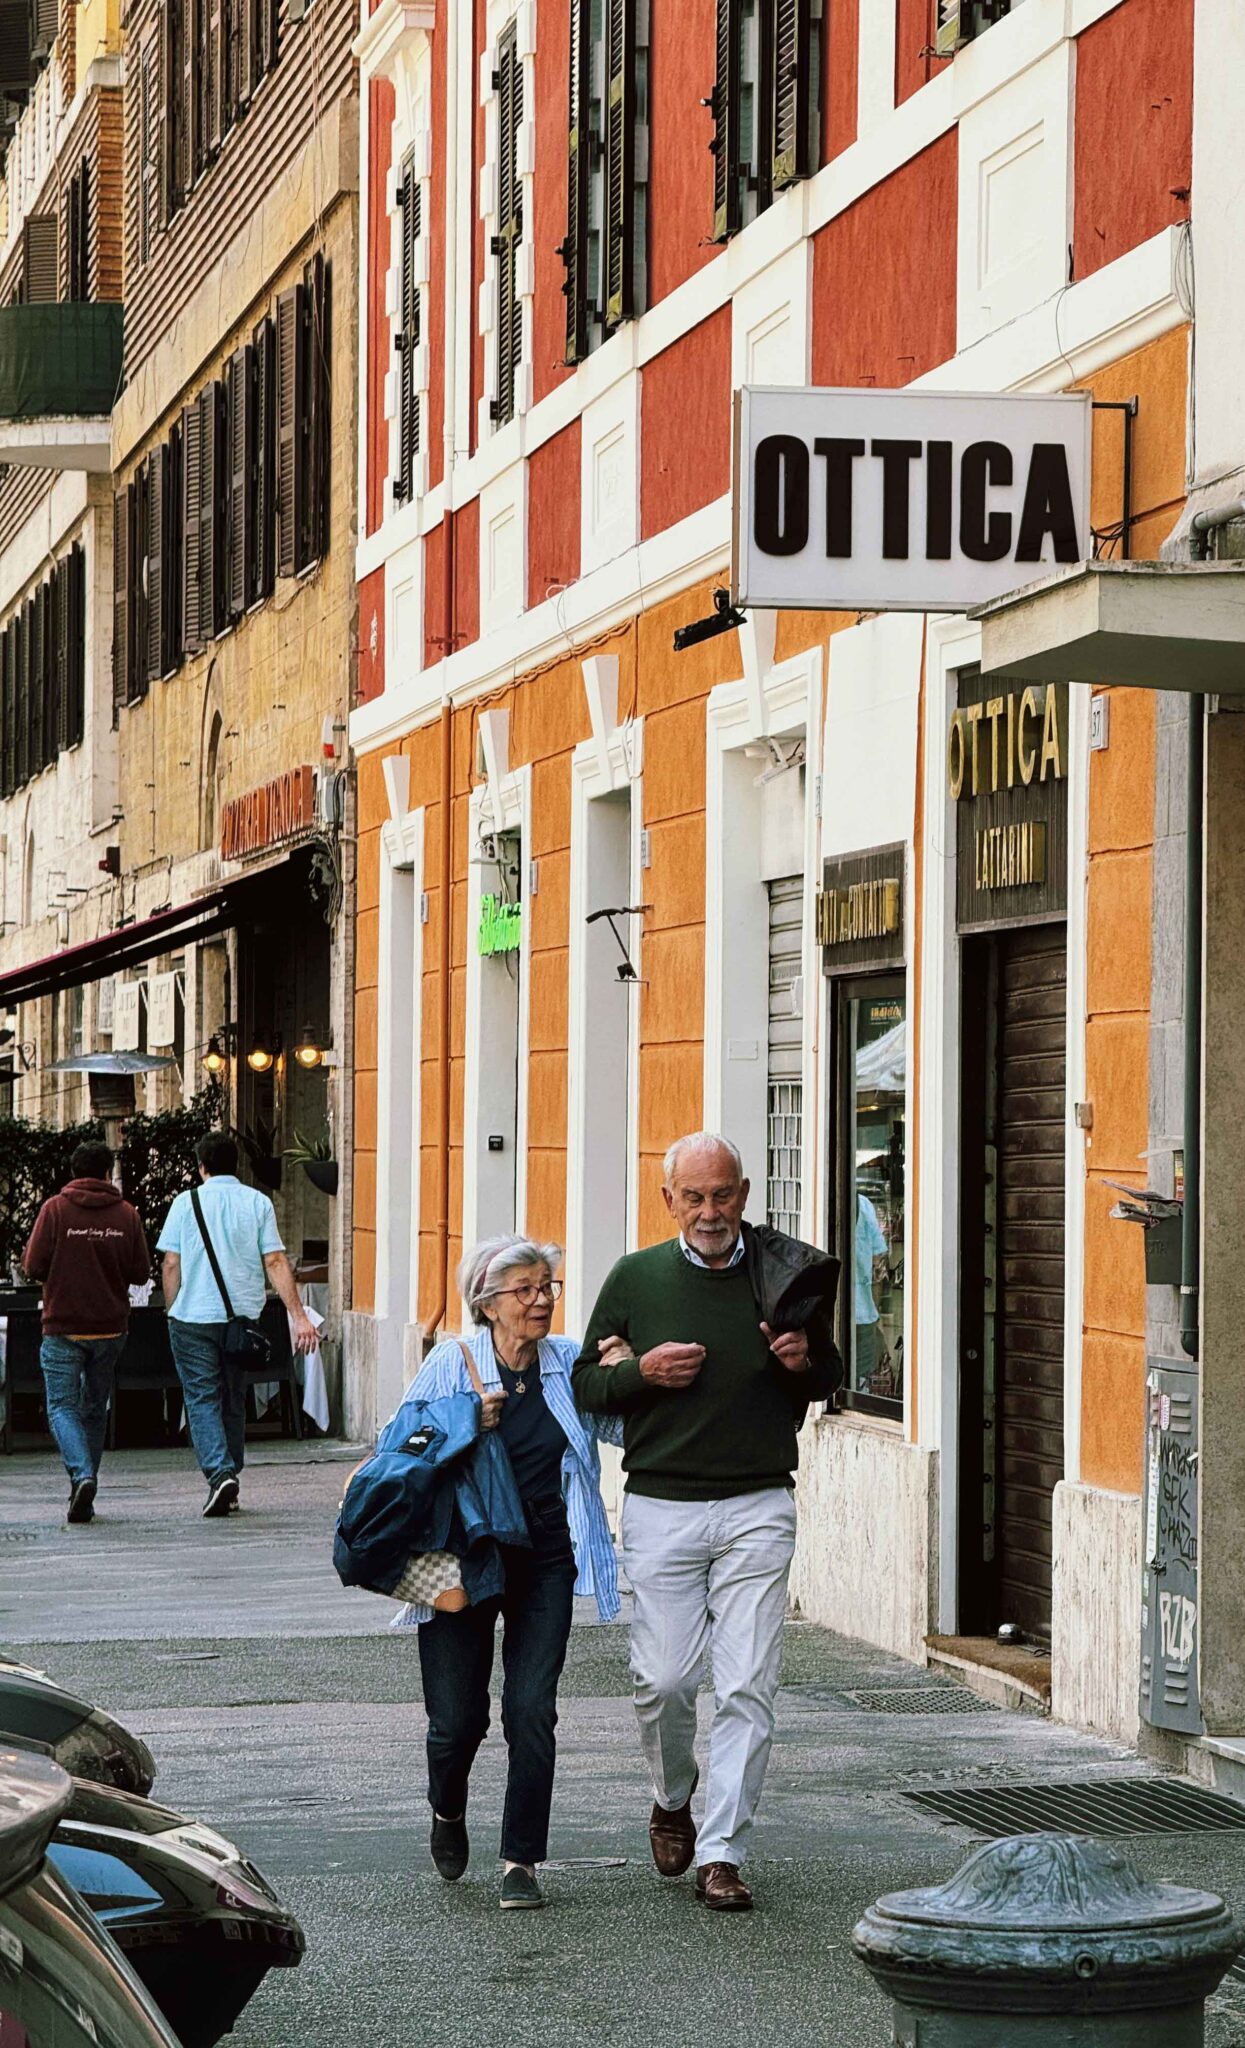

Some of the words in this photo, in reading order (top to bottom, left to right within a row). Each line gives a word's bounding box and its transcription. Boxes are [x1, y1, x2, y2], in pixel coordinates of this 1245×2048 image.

[755, 434, 1079, 563] OTTICA
[948, 682, 1062, 801] OTTICA
[975, 820, 1034, 890] LATTARINI
